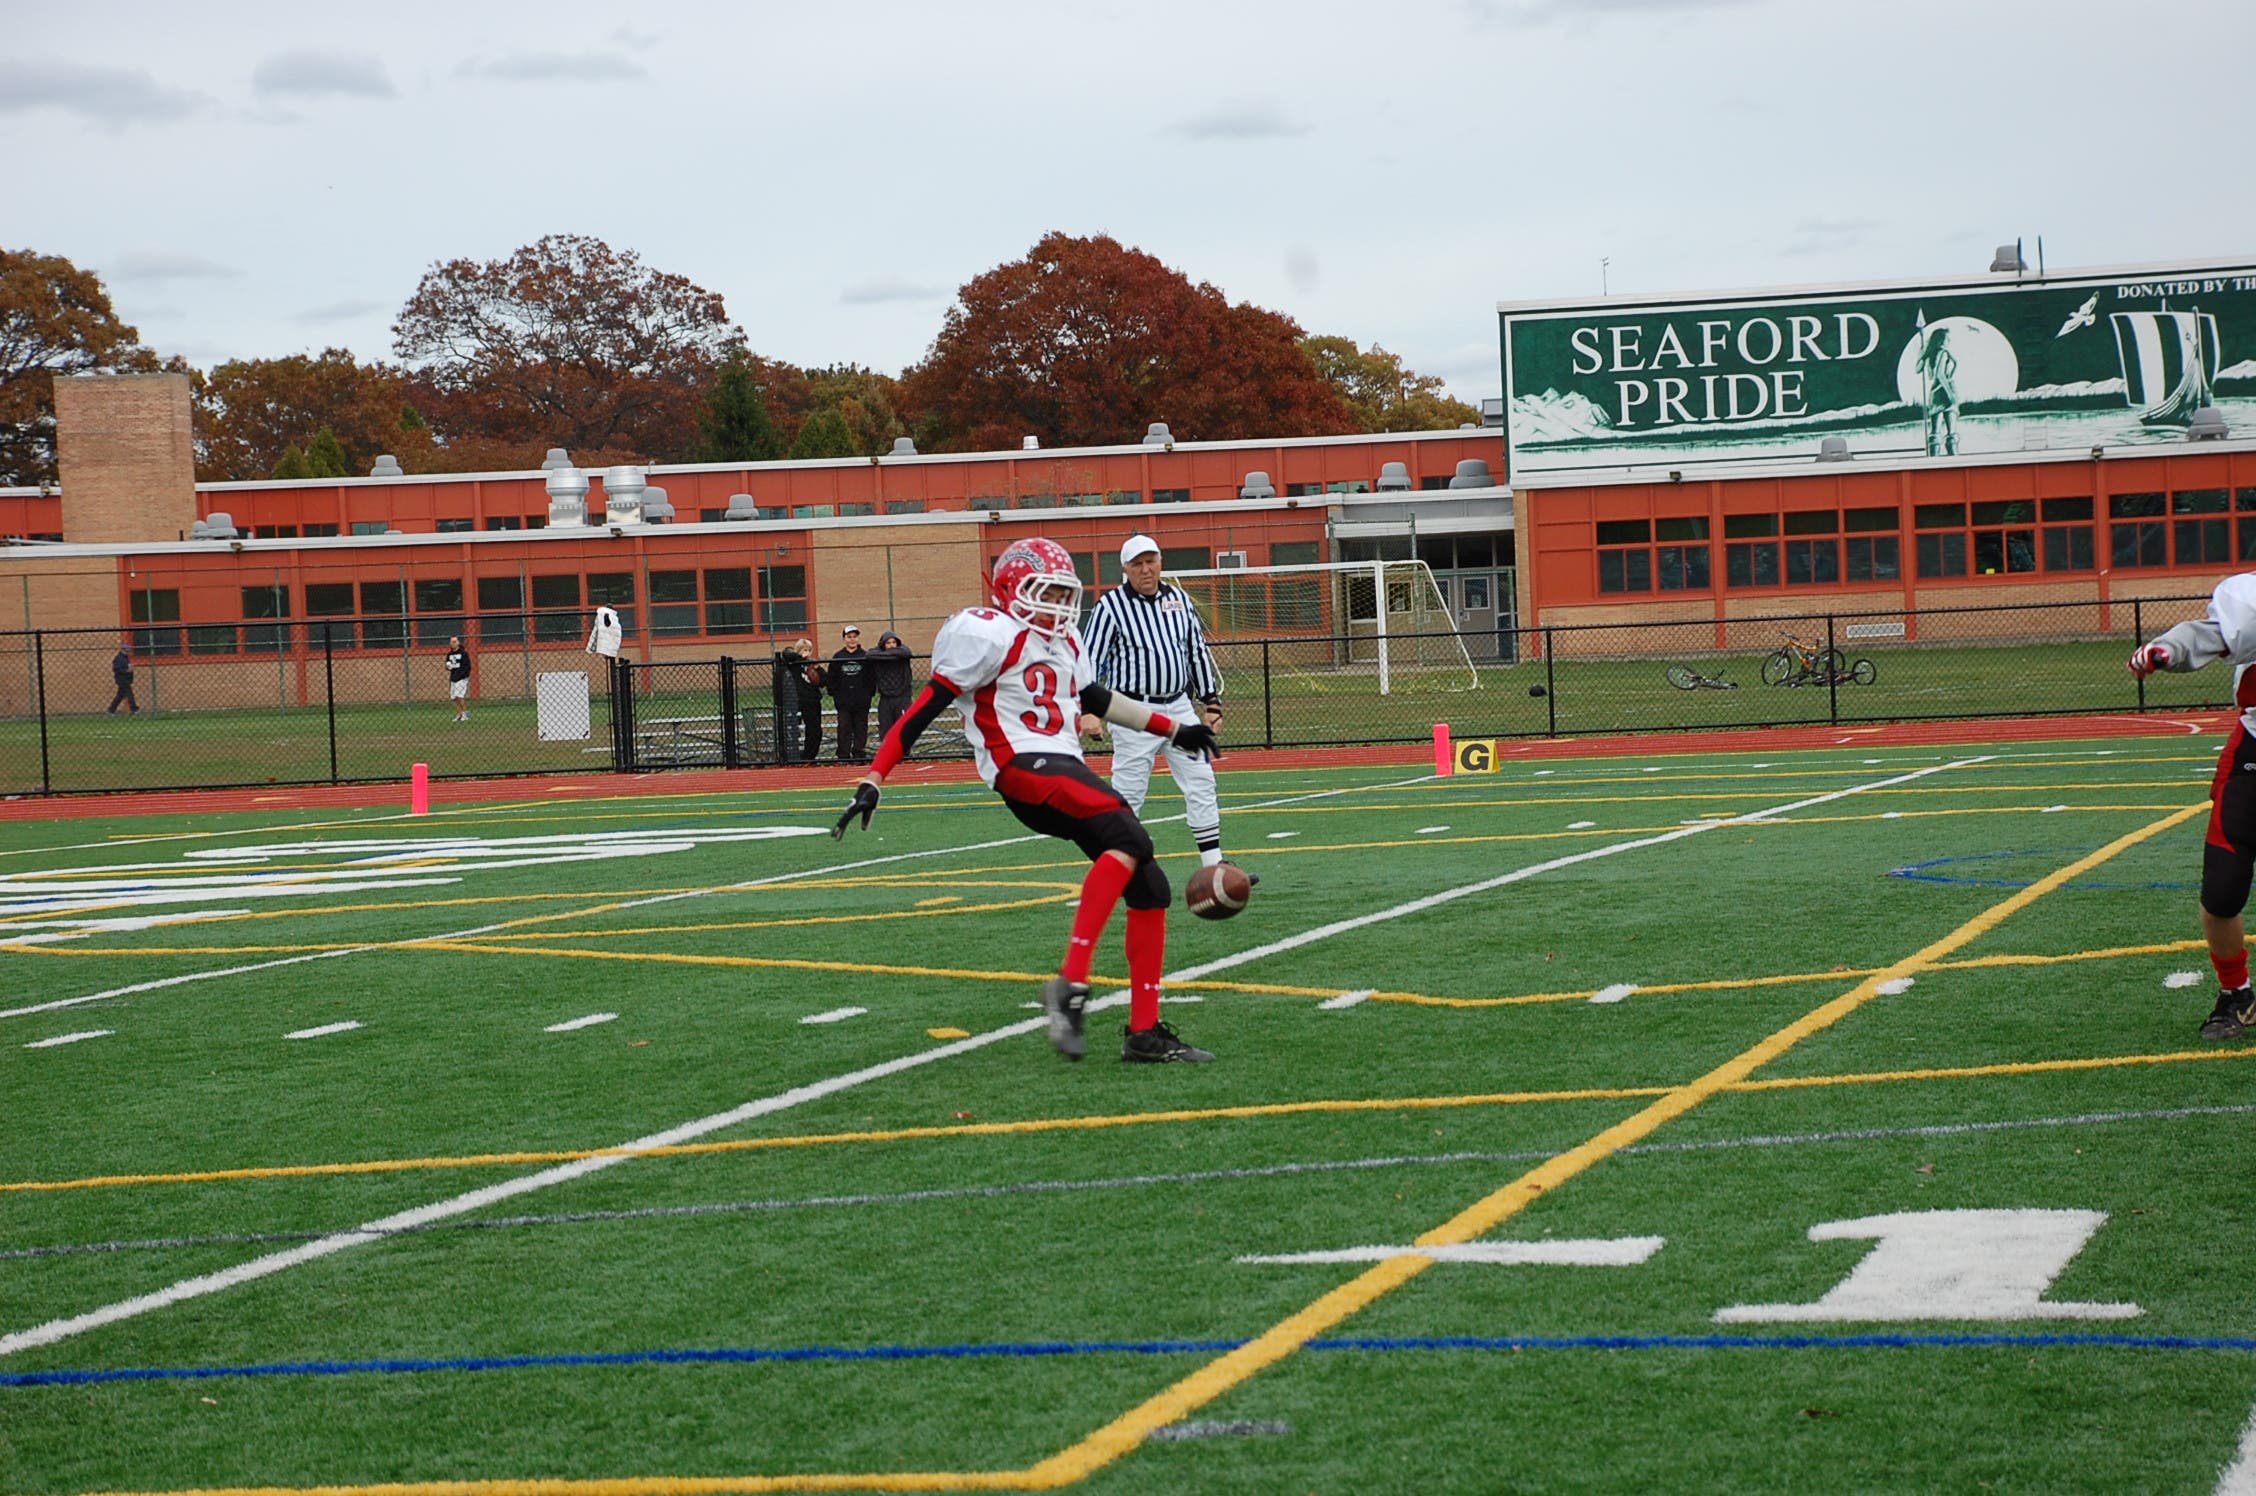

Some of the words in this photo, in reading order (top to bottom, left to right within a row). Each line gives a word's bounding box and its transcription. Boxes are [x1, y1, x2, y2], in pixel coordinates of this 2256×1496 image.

[2117, 281, 2199, 299] DONATED
[2203, 279, 2228, 293] BY
[1571, 312, 1880, 374] SEAFORD
[1614, 370, 1808, 426] PRIDE
[1460, 743, 1490, 771] G
[1711, 1209, 2147, 1323] 1
